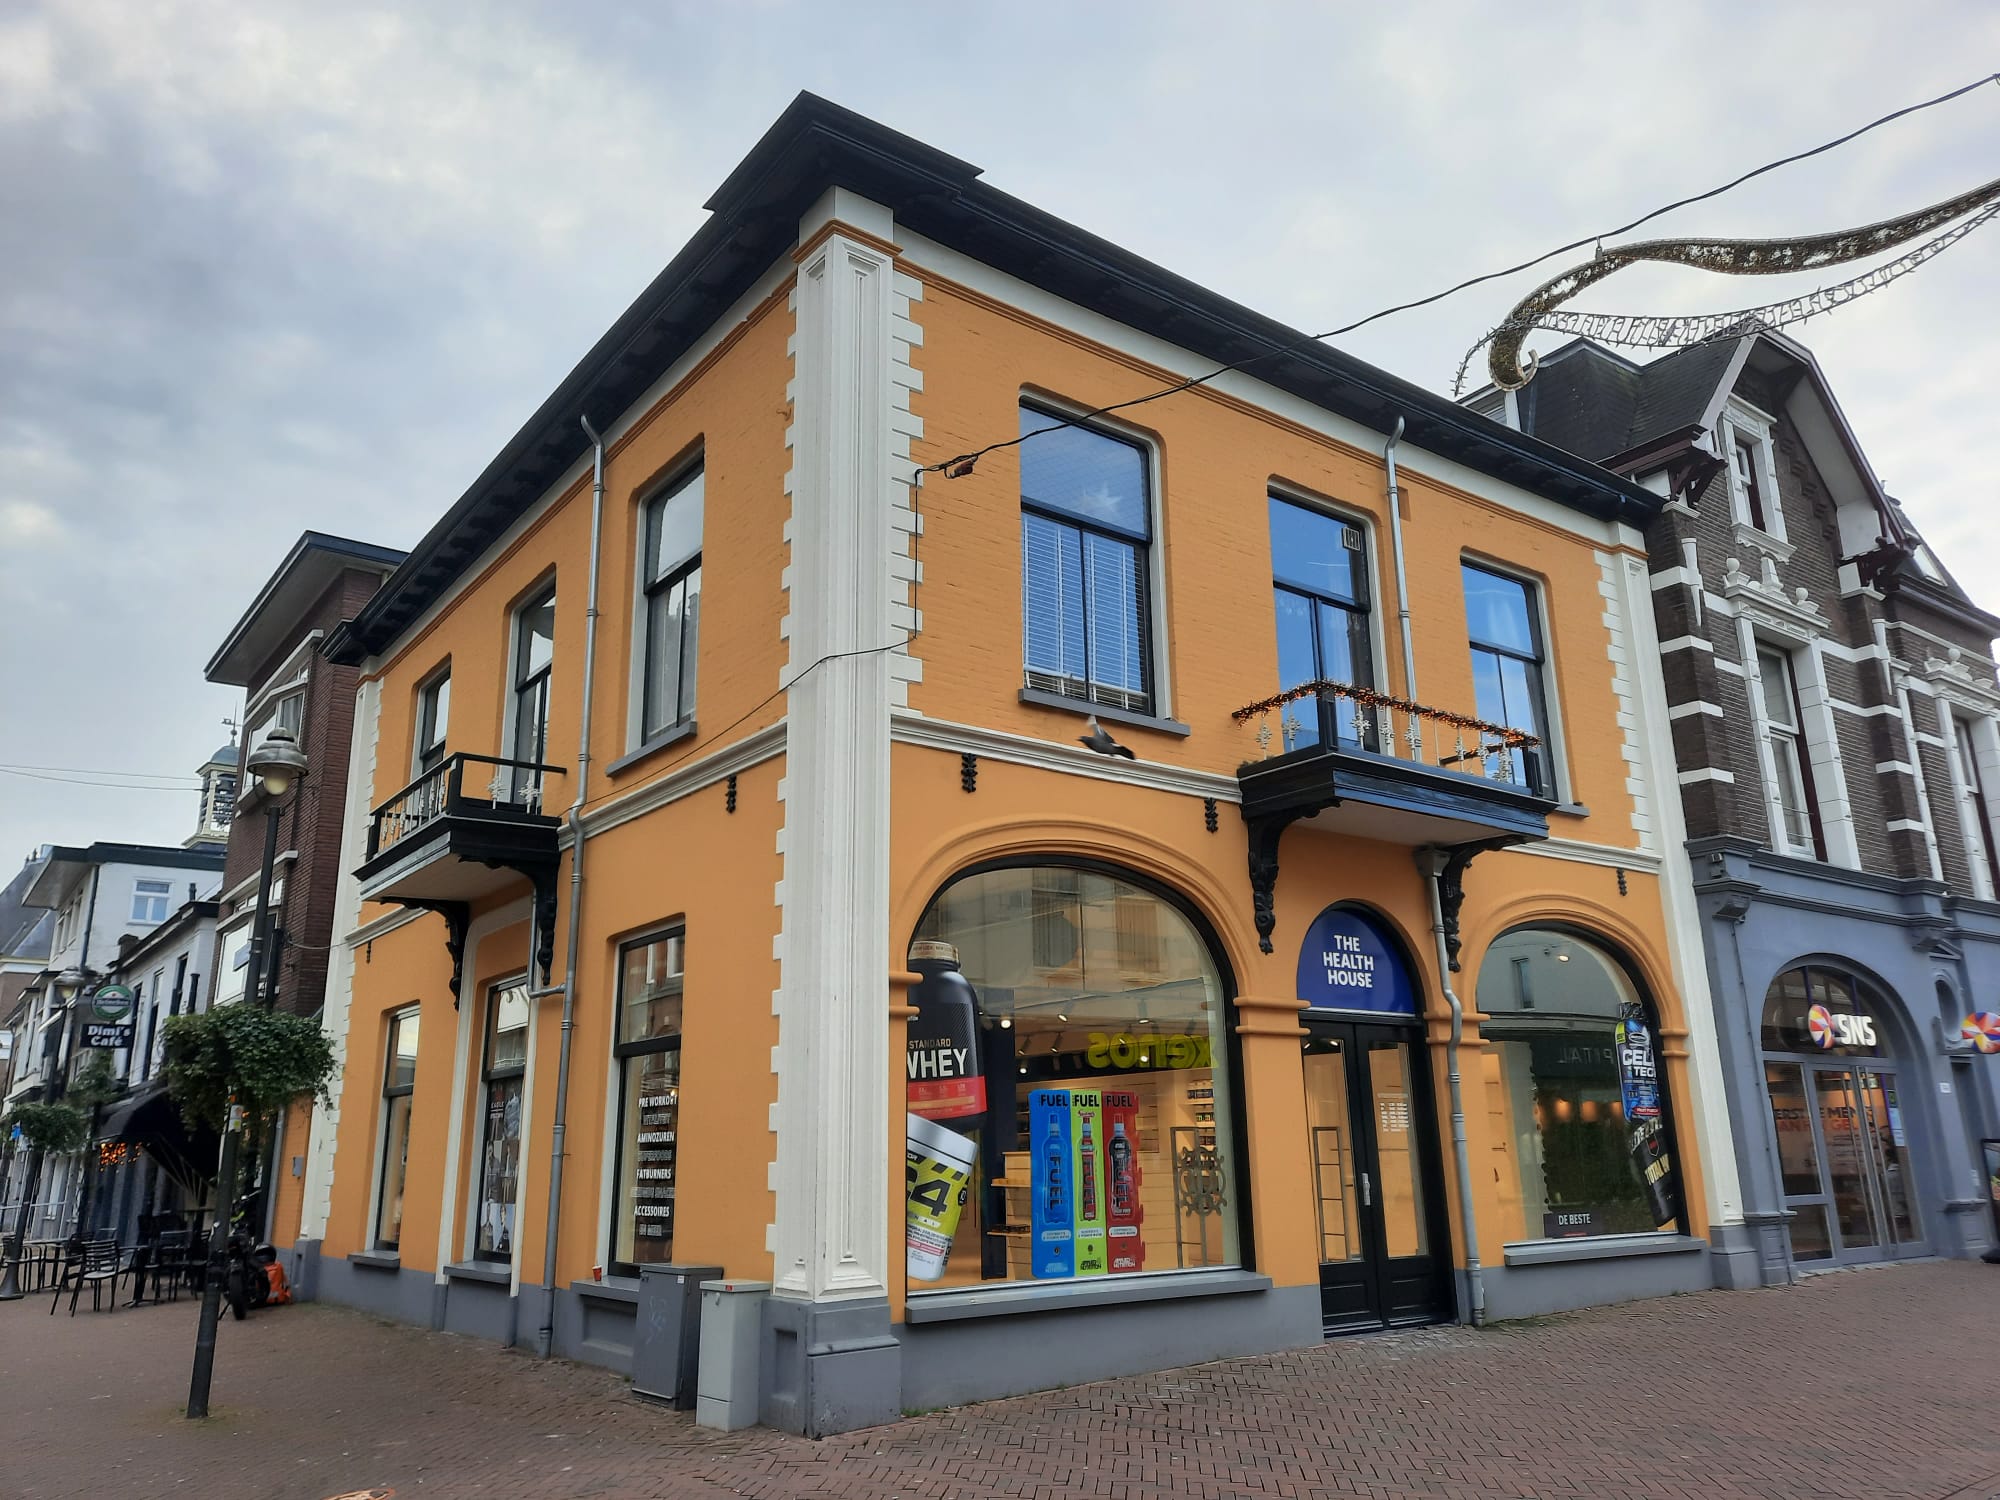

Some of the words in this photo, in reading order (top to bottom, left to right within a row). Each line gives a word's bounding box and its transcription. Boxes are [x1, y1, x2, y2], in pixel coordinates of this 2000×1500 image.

[1334, 934, 1361, 952] THE
[1323, 951, 1375, 971] HEALTH
[1327, 969, 1373, 988] HOUSE
[87, 1025, 131, 1037] Dimi's
[1838, 1013, 1877, 1047] SNS
[90, 1035, 123, 1047] Café
[908, 1038, 951, 1050] STANDARD
[639, 1097, 649, 1108] PRE
[1040, 1094, 1068, 1107] FUEL
[1074, 1094, 1100, 1108] FUEL
[1106, 1095, 1133, 1108] FUEL
[637, 1132, 675, 1143] AMINOZUREN
[636, 1168, 672, 1180] FATBURNERS
[633, 1205, 670, 1218] ACCESSOIRES
[1558, 1214, 1569, 1226] DE
[1569, 1213, 1592, 1225] BESTE
